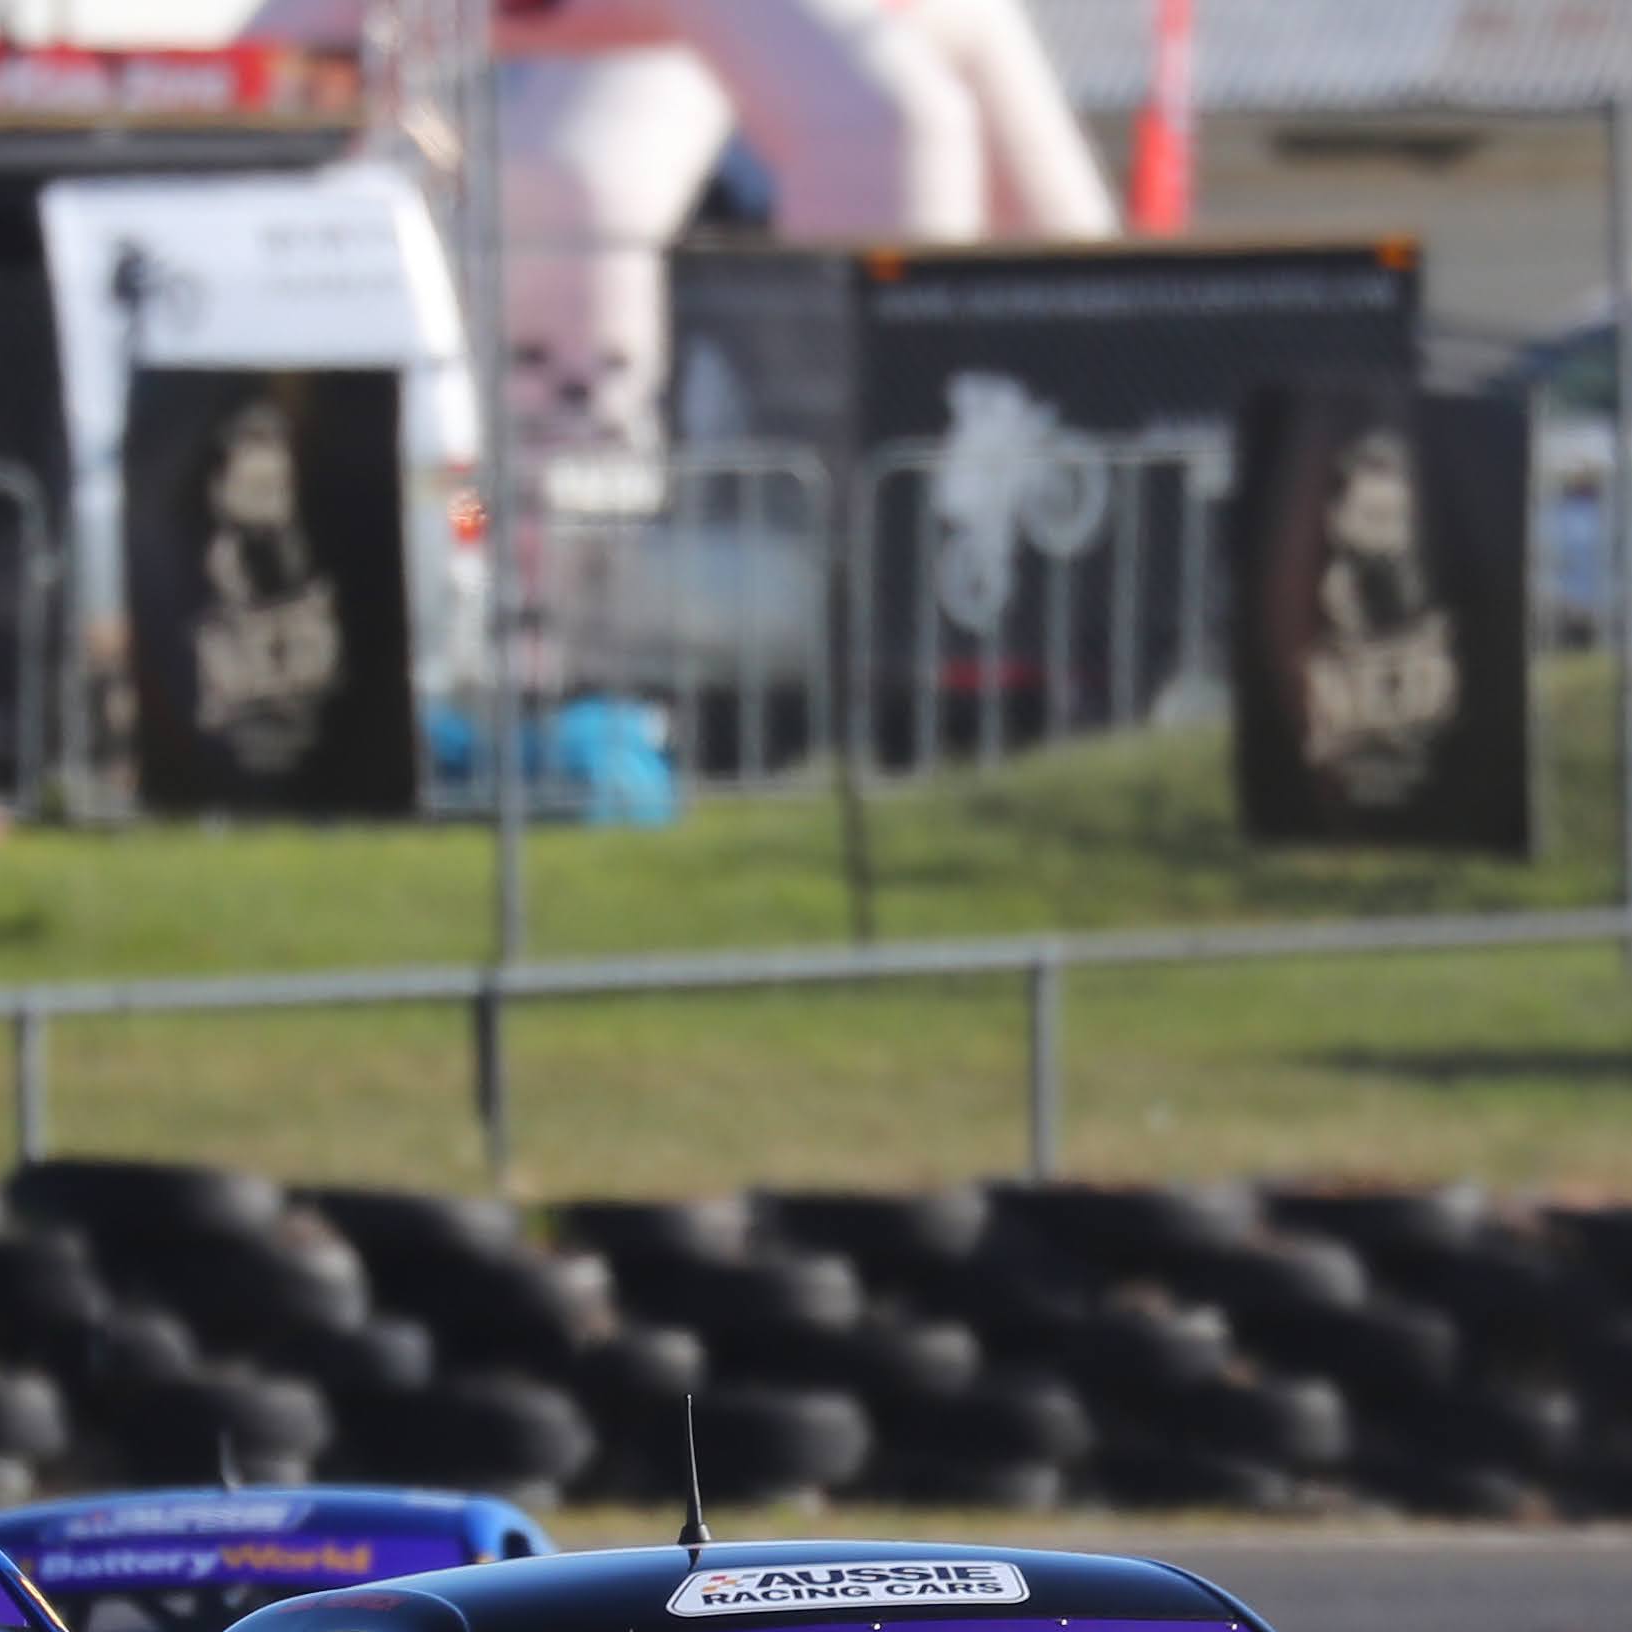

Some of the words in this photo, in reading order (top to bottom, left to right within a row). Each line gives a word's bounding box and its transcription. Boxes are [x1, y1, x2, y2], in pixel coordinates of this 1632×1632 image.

[756, 1565, 999, 1587] AUSSIE
[701, 1583, 869, 1606] RACING
[885, 1580, 1004, 1598] CARS
